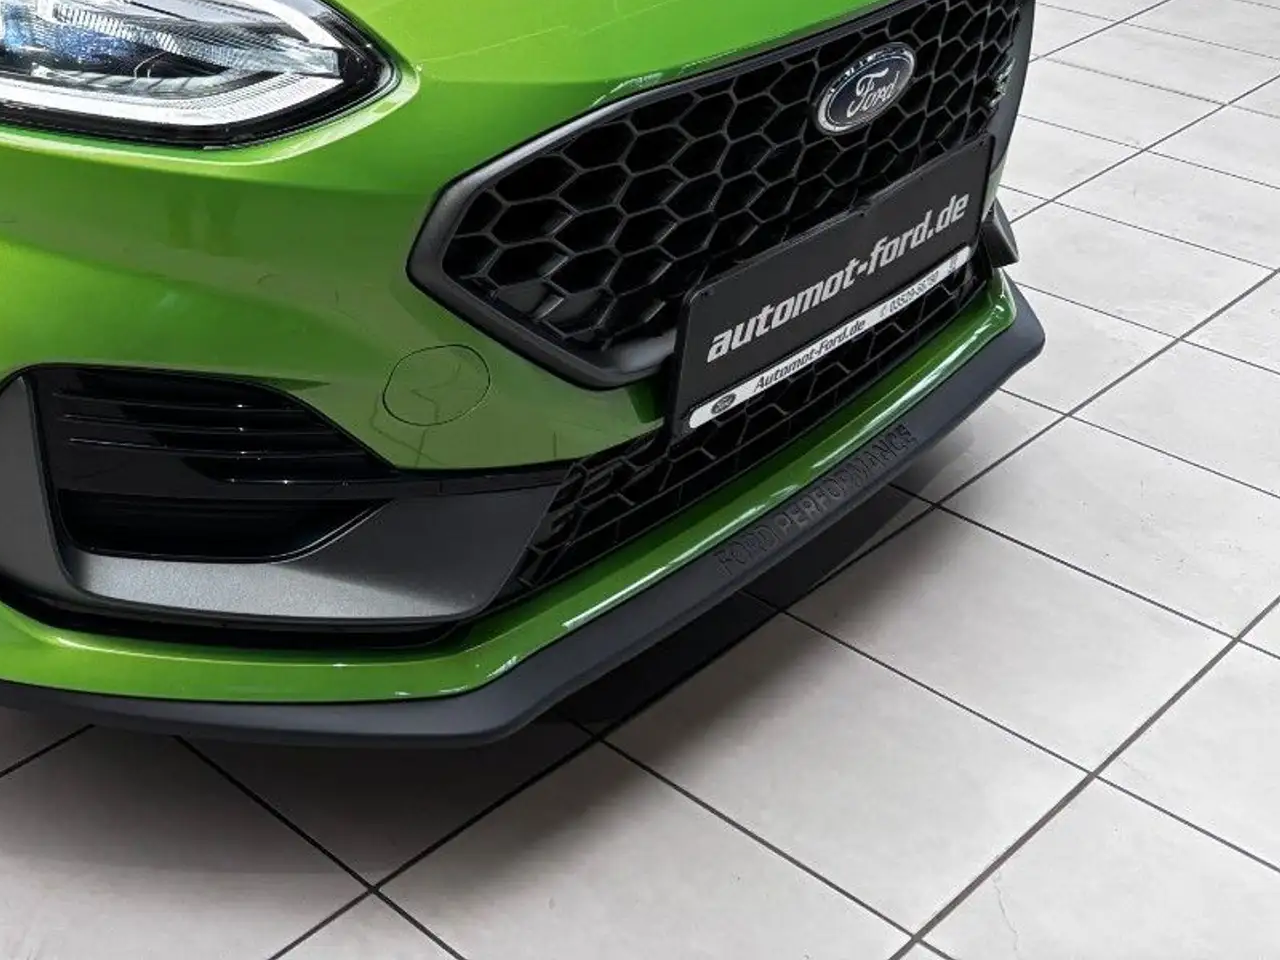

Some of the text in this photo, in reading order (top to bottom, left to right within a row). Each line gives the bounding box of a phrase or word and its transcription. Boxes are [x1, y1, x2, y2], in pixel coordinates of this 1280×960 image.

[846, 66, 900, 118] Ford
[706, 193, 970, 364] automot-ford.de
[753, 319, 866, 392] Automot-Ford.de
[776, 423, 916, 532] PERFORMANCE
